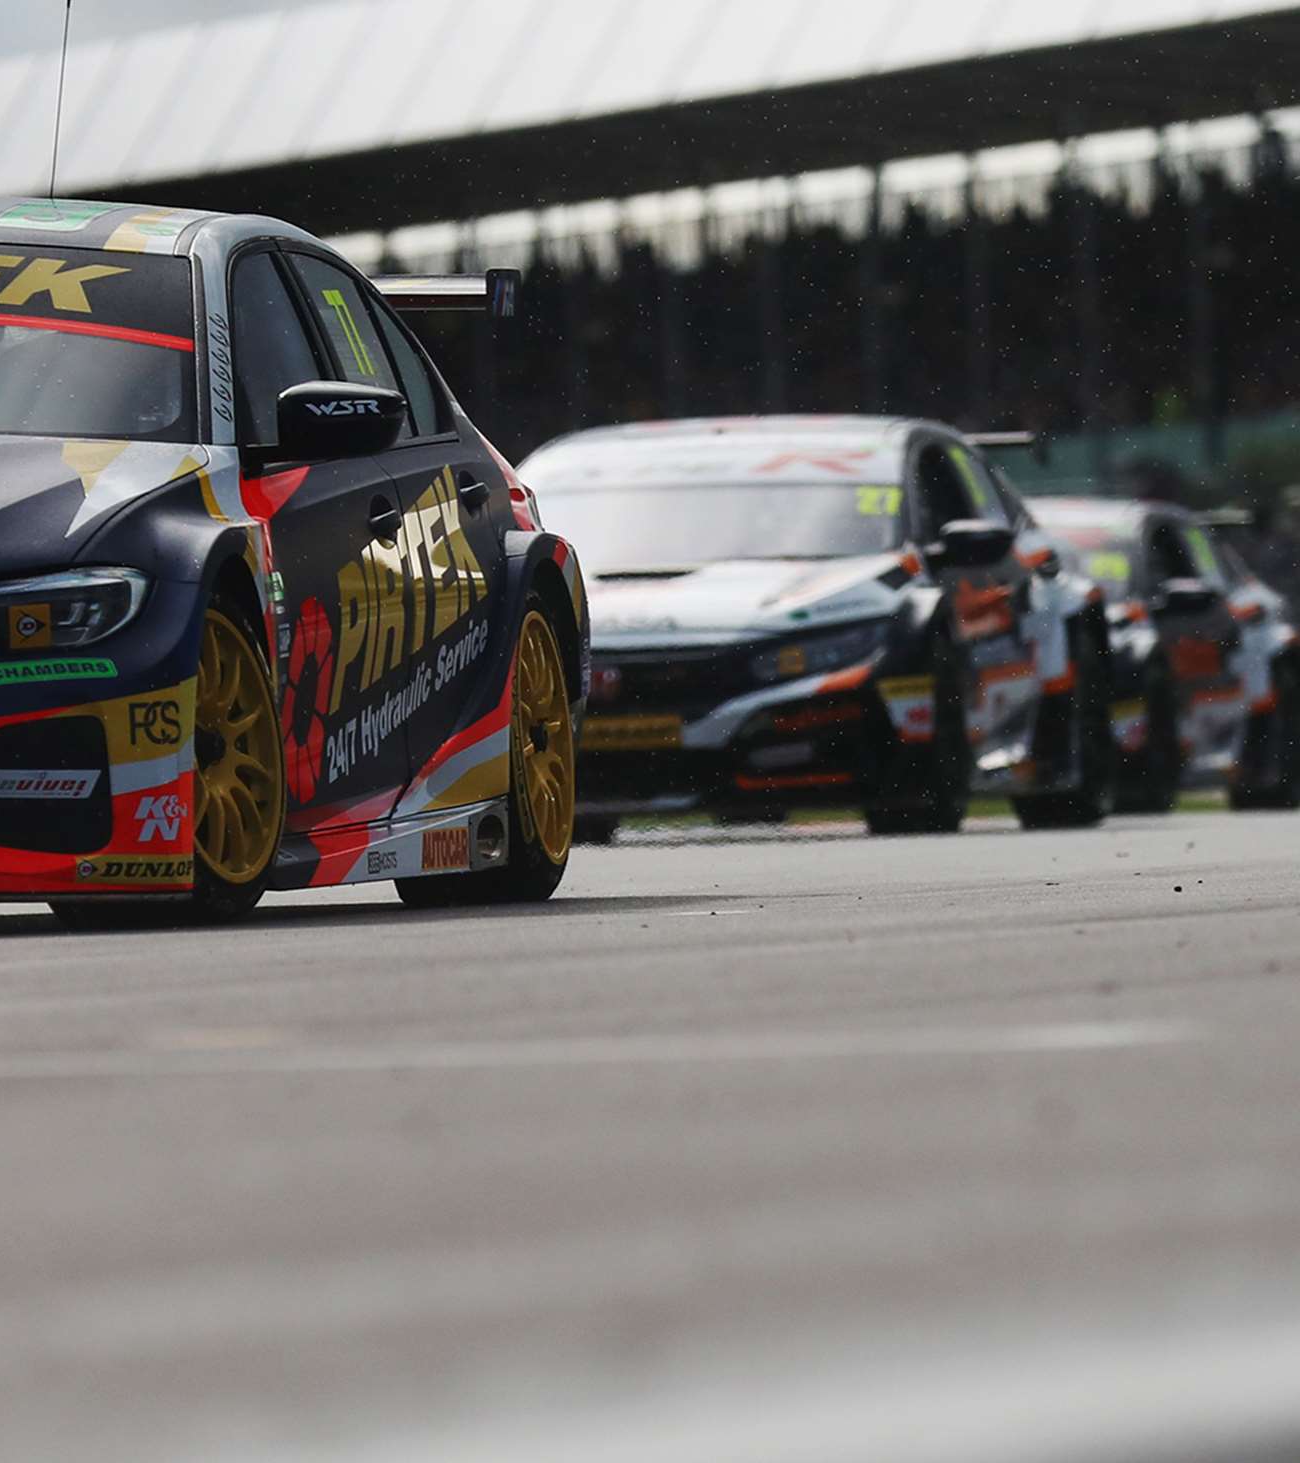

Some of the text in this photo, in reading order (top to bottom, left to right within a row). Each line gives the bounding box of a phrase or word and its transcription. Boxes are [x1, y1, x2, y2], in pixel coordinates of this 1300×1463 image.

[322, 289, 376, 376] 77
[305, 400, 381, 416] WSR
[328, 464, 488, 716] PIRTEK
[327, 619, 488, 784] 24/7 Hydraulic Service
